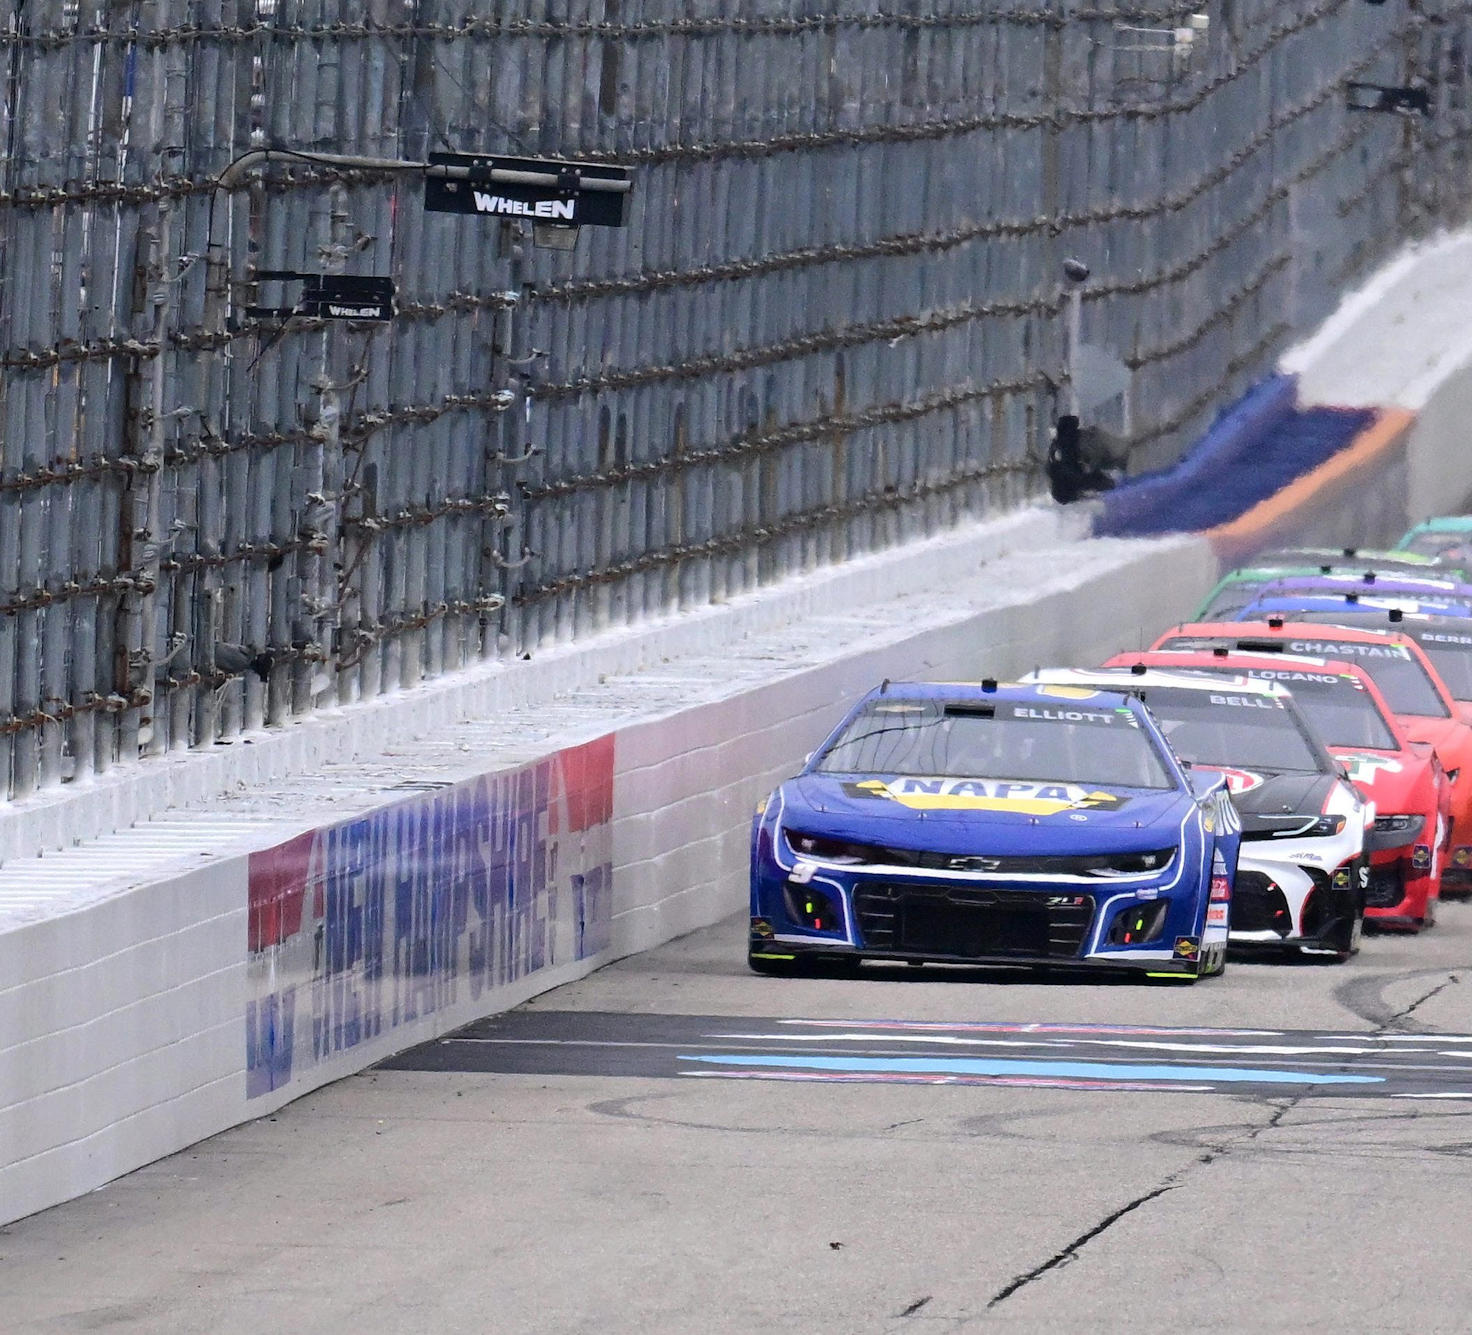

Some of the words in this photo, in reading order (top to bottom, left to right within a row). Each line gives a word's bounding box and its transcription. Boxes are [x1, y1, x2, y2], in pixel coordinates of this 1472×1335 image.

[473, 191, 574, 219] WHELEN
[329, 305, 380, 317] WHELEN
[1291, 642, 1404, 659] CHASTAIN
[1248, 670, 1338, 684] LOGANO
[1209, 695, 1272, 709] BELL
[1014, 708, 1115, 724] ELLIOTT
[902, 779, 1072, 801] NAPA
[788, 863, 818, 884] 9
